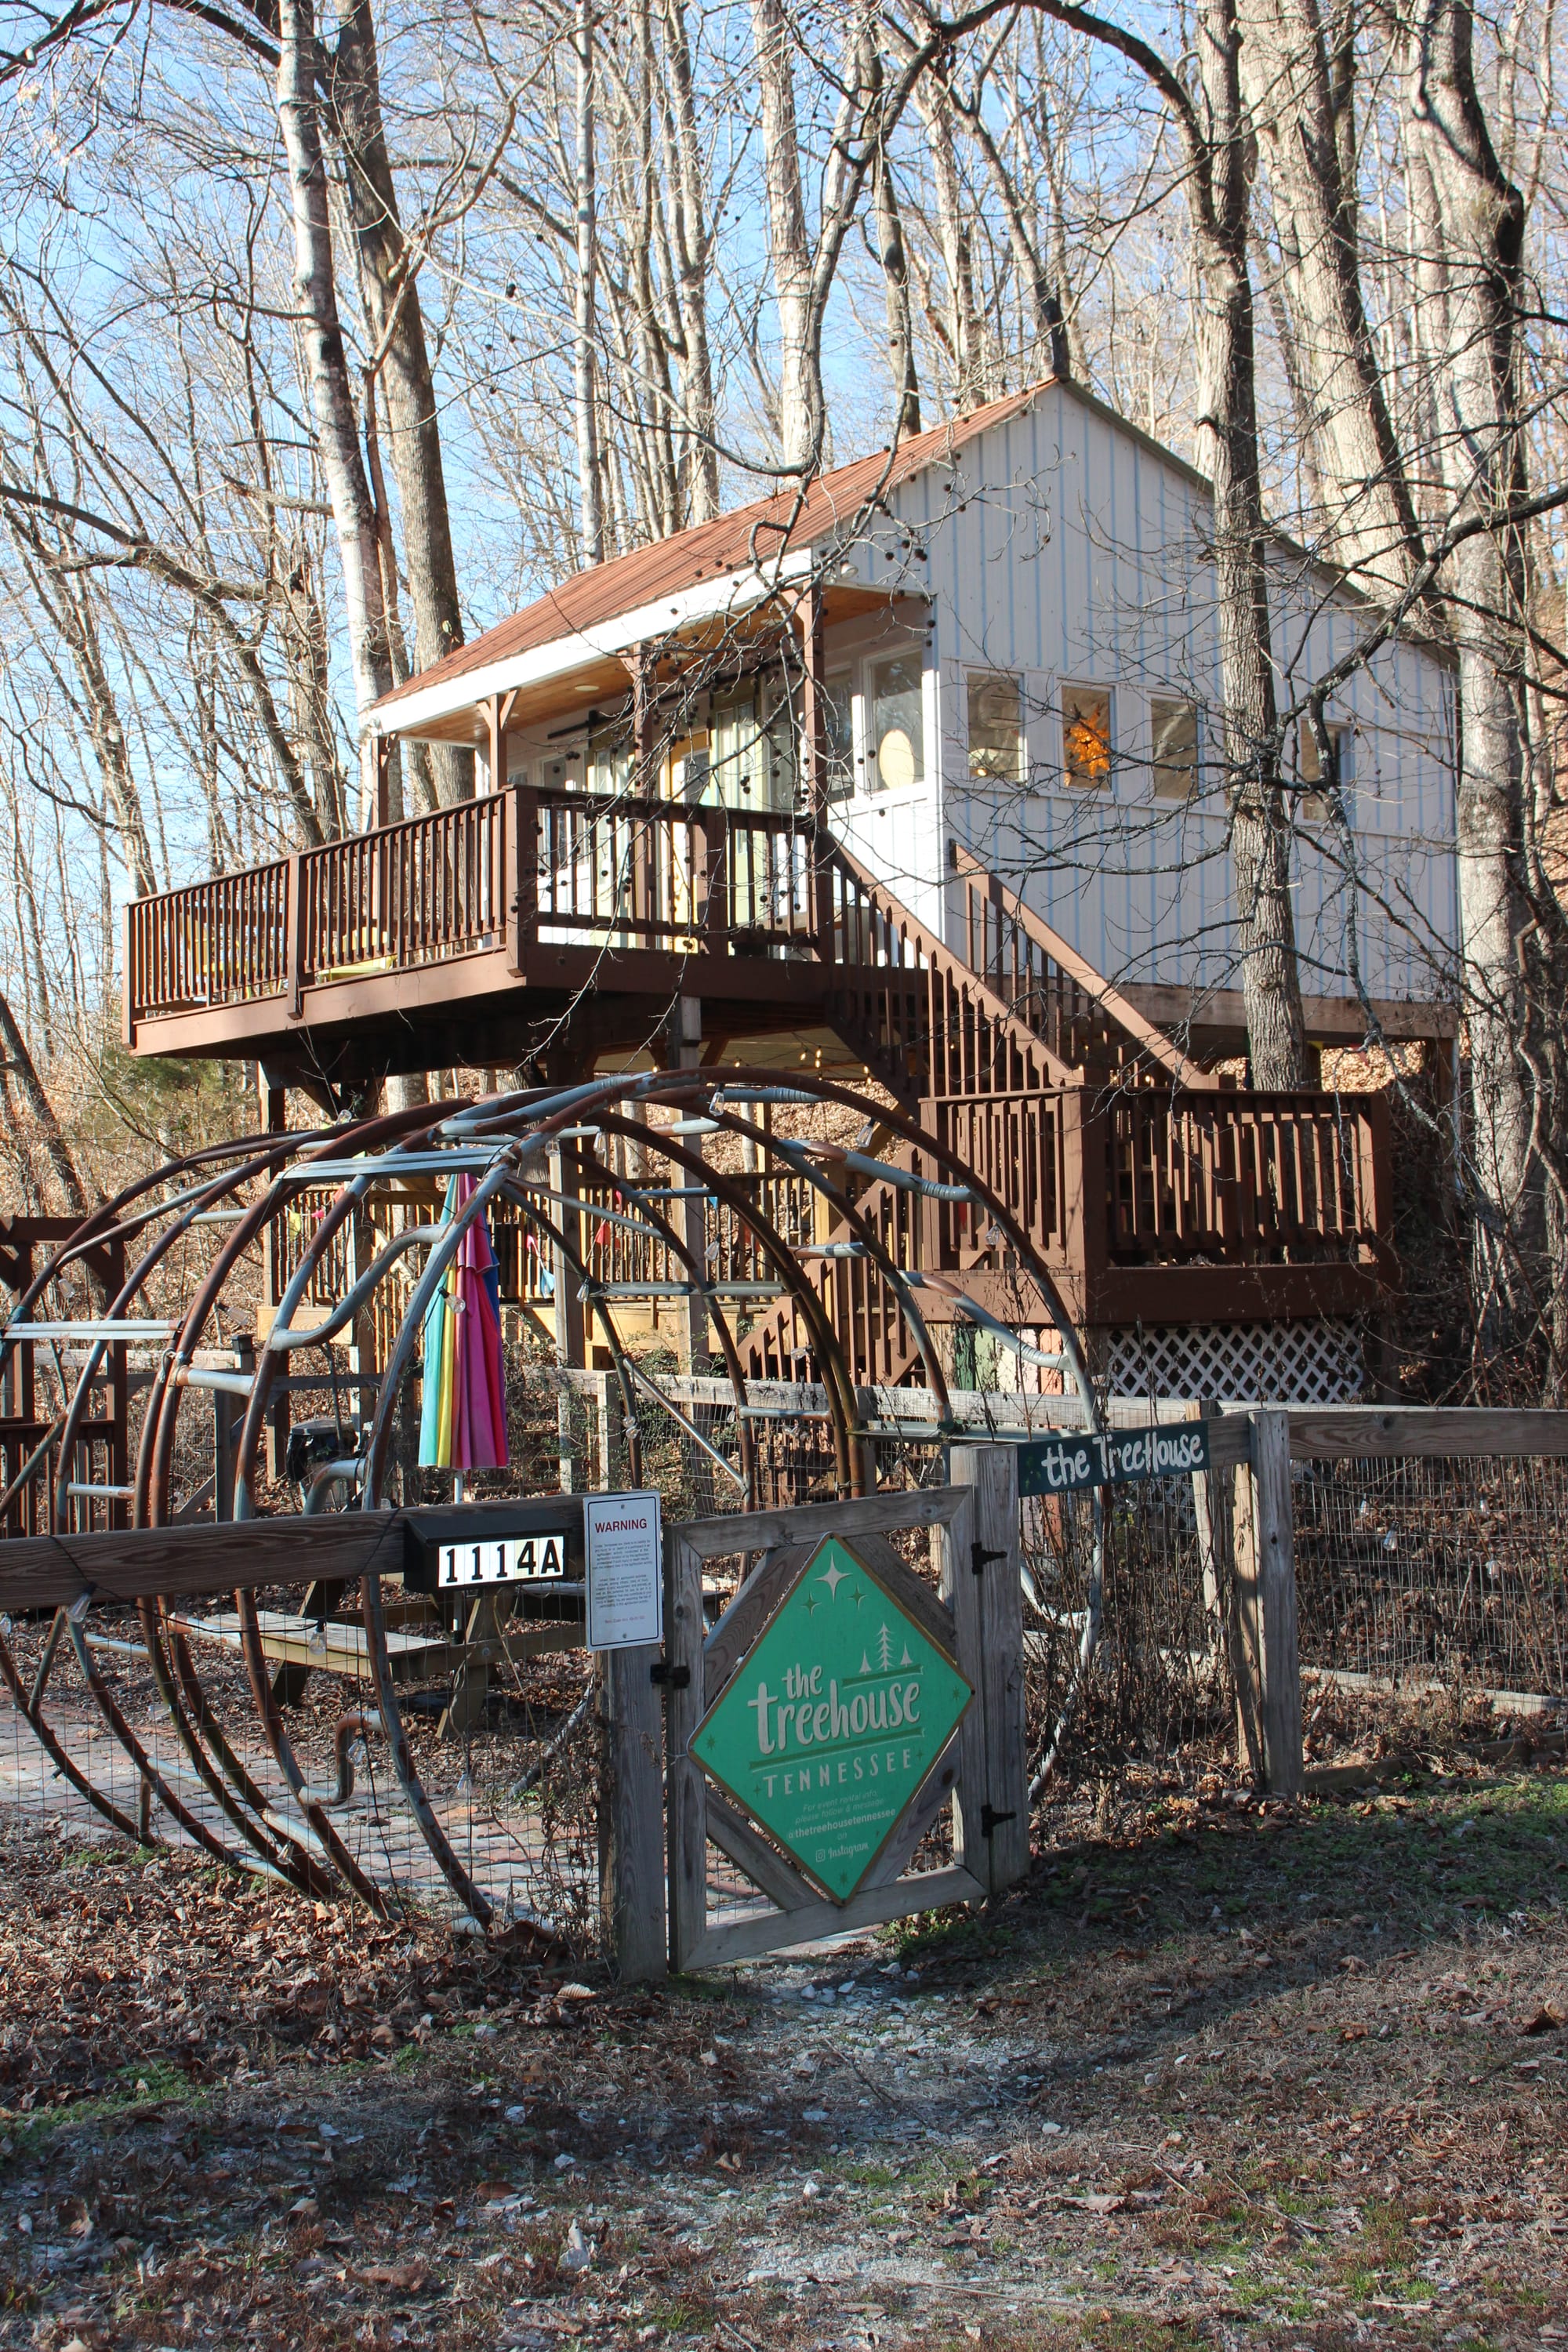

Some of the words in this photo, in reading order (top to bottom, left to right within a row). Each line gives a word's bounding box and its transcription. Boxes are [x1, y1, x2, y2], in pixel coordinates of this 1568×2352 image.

[1041, 1443, 1090, 1487] the
[595, 1519, 647, 1534] WARNING
[446, 1539, 561, 1583] 1114A
[782, 1663, 822, 1700] the
[747, 1679, 921, 1755] treehouse
[763, 1748, 912, 1798] TENNESSEE
[795, 1813, 819, 1825] please
[821, 1806, 844, 1818] follow
[852, 1798, 884, 1812] message
[803, 1804, 816, 1813] For
[817, 1798, 838, 1809] event
[840, 1792, 861, 1805] rental
[789, 1808, 896, 1841] @thetreehousetennessee
[837, 1831, 848, 1840] on
[828, 1842, 869, 1859] Instagram
